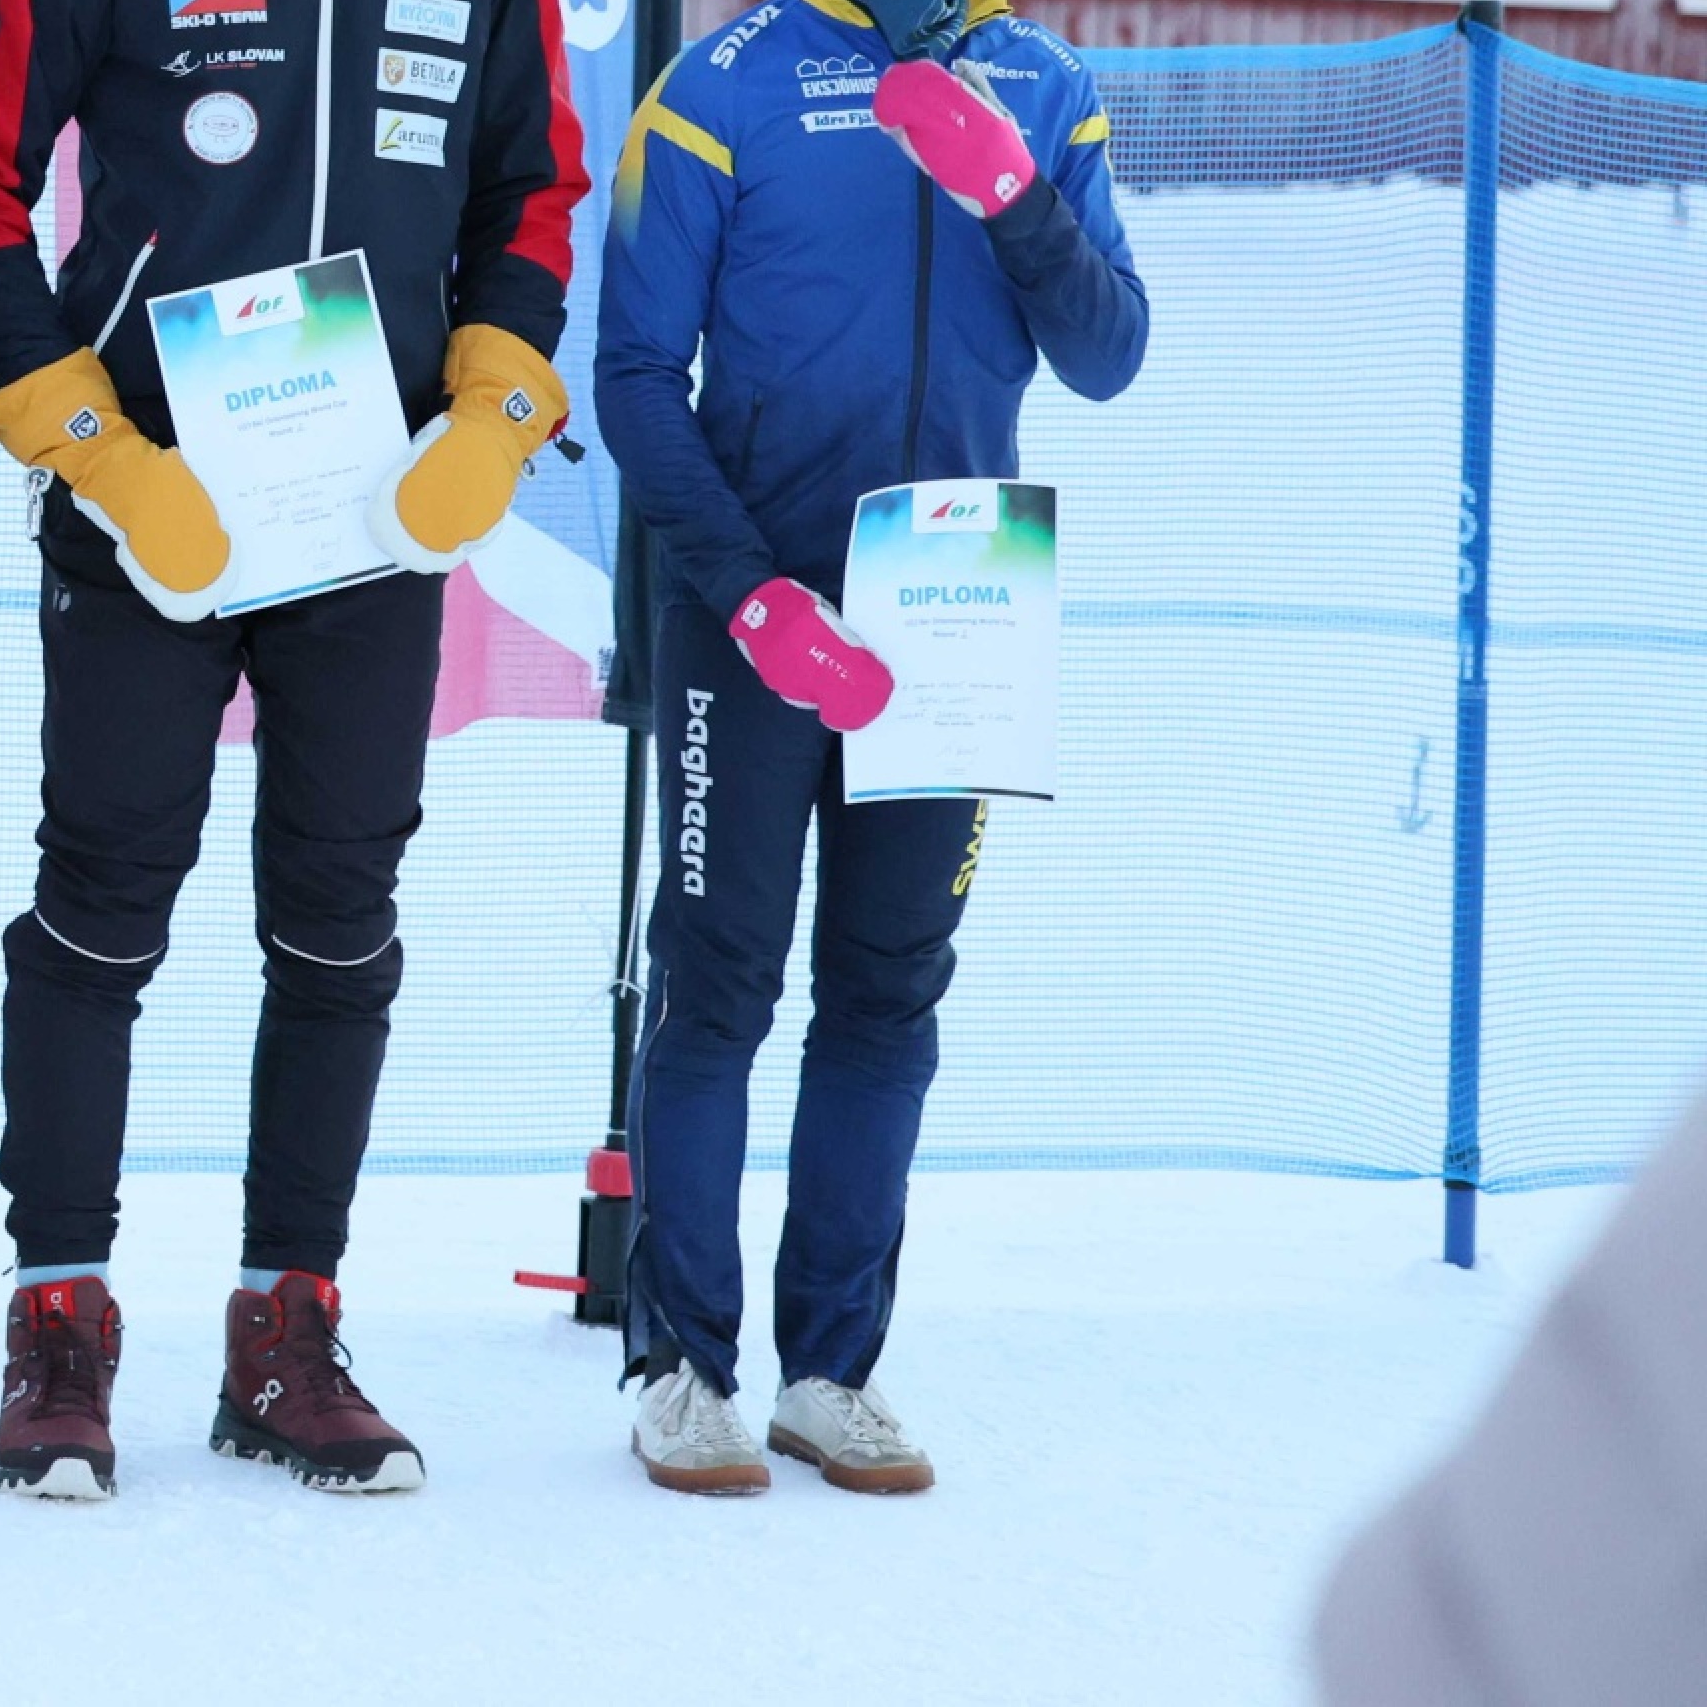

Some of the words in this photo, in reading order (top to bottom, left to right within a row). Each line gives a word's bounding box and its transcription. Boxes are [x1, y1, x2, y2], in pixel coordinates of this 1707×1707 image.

[219, 9, 268, 26] TEAM
[206, 50, 225, 64] LK
[226, 48, 286, 63] SLOVAN
[411, 60, 456, 84] BETULA
[224, 369, 337, 413] DIPLOMA
[898, 586, 1011, 606] DIPLOMA
[681, 688, 715, 898] bagheera
